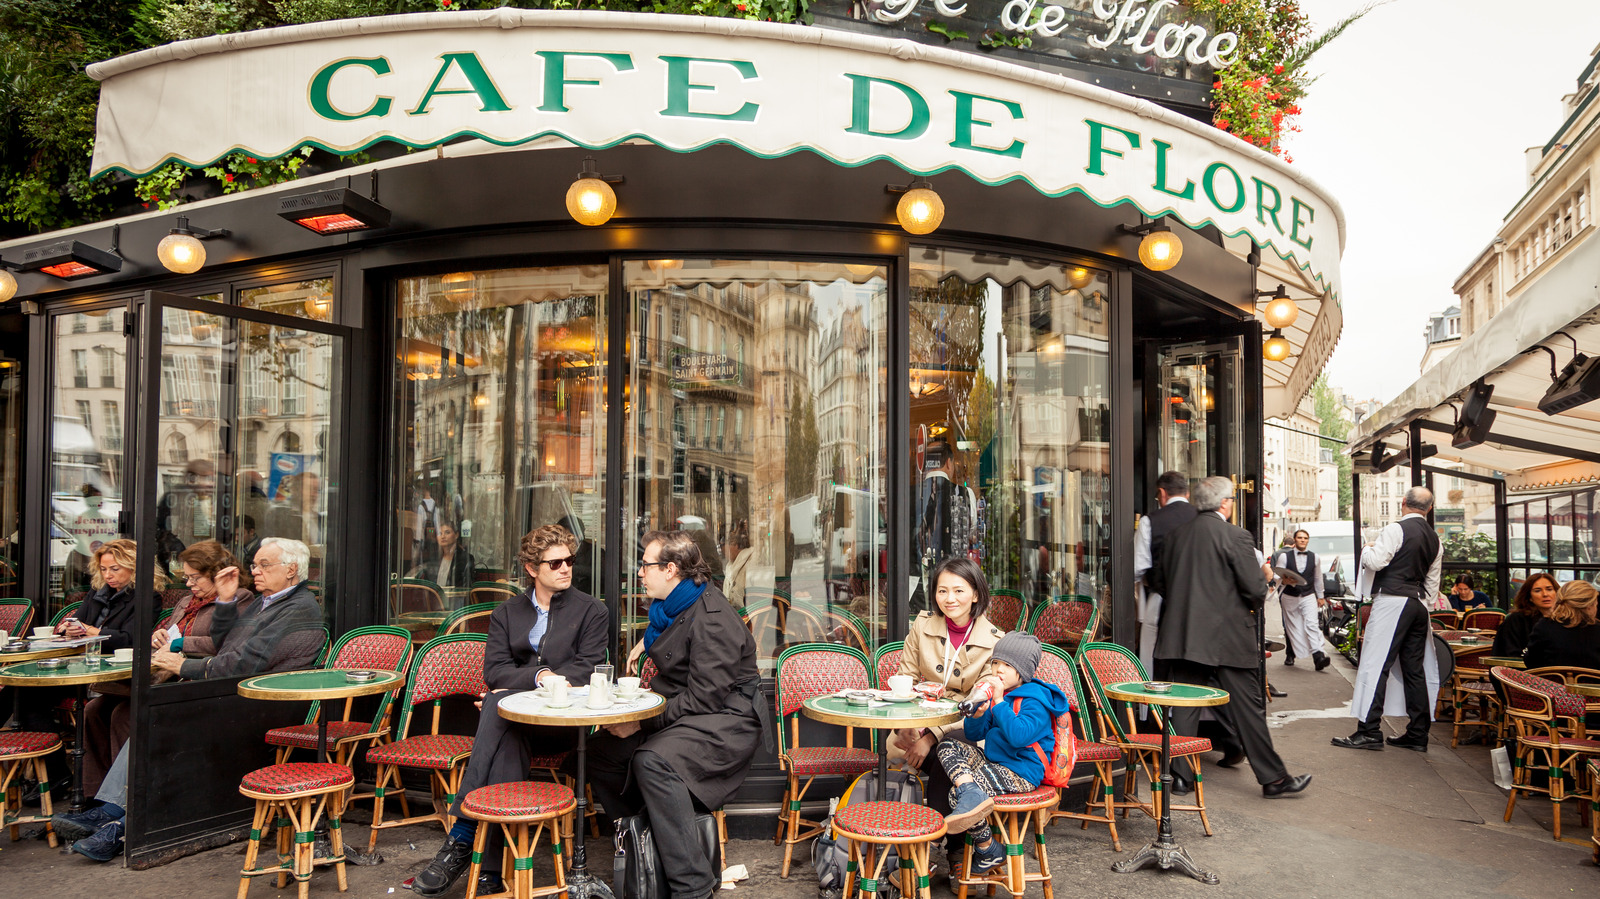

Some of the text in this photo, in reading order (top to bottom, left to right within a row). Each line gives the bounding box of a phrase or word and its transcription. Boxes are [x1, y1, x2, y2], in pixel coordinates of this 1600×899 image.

[1000, 0, 1069, 37] de
[1086, 0, 1239, 69] Flore
[307, 50, 1315, 250] CAFE DE FLORE
[675, 366, 734, 379] SAINT GERMAIN
[681, 354, 727, 367] BOULEVARD
